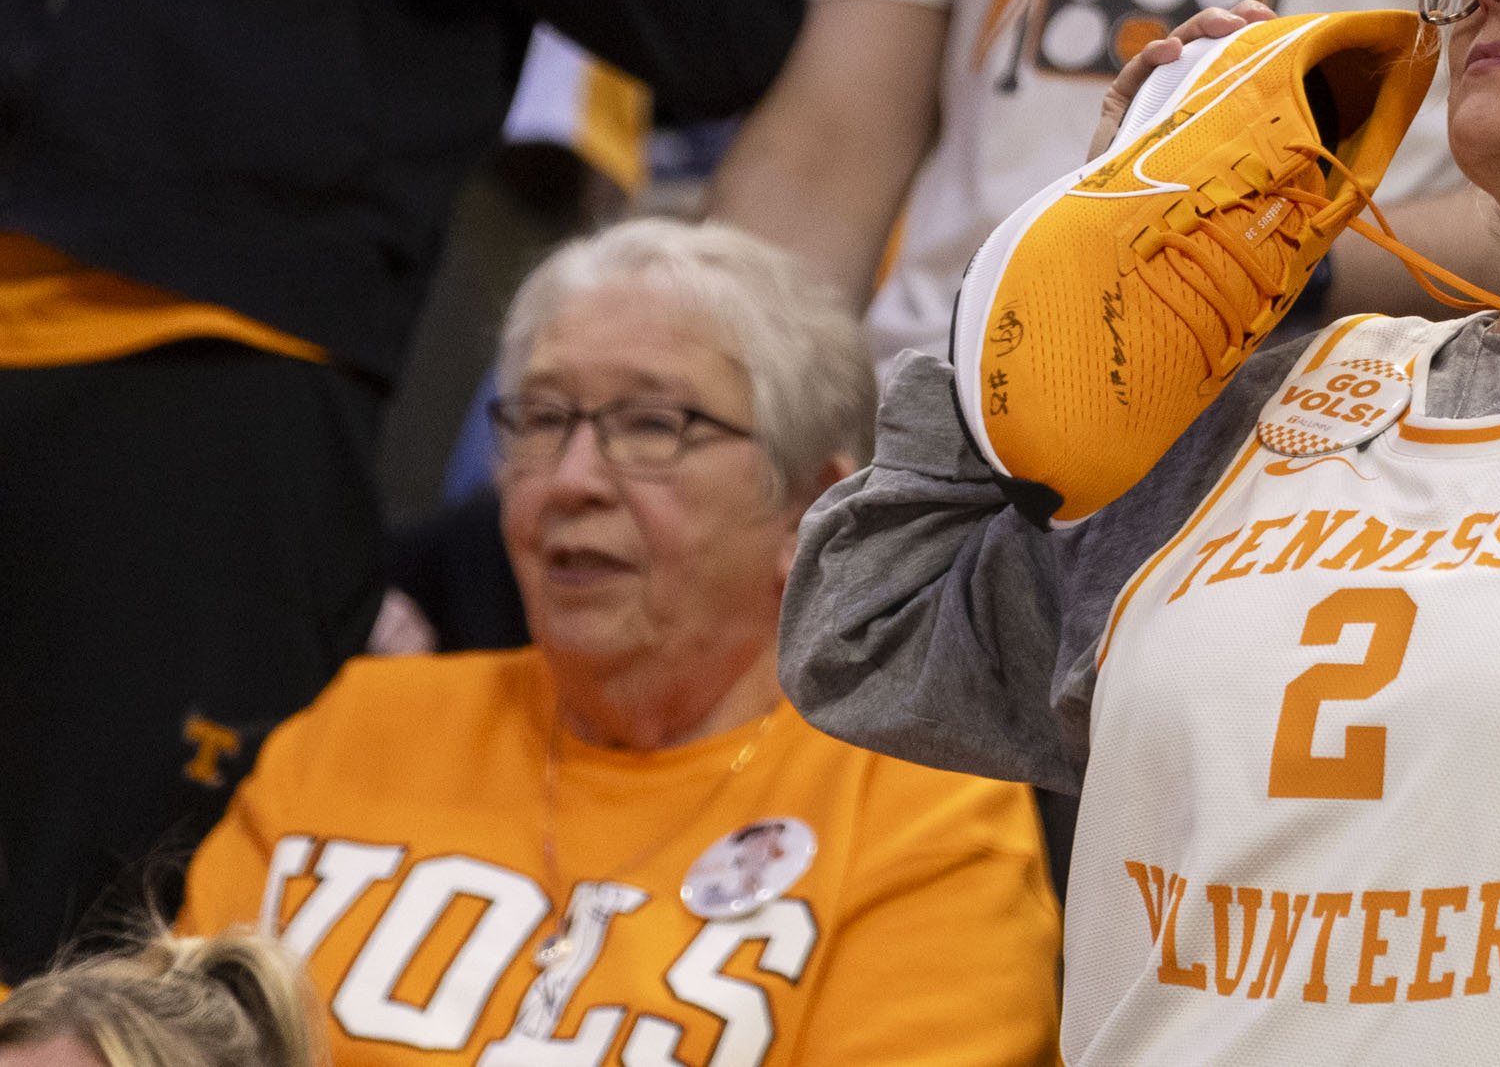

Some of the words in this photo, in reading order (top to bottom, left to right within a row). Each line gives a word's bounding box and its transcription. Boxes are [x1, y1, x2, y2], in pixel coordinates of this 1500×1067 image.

[1257, 199, 1283, 229] PEGASUS
[1245, 227, 1257, 240] 38
[1326, 373, 1381, 398] GO
[1280, 385, 1387, 428] VOLS!
[1268, 588, 1418, 800] 2
[259, 833, 820, 1067] VOLS
